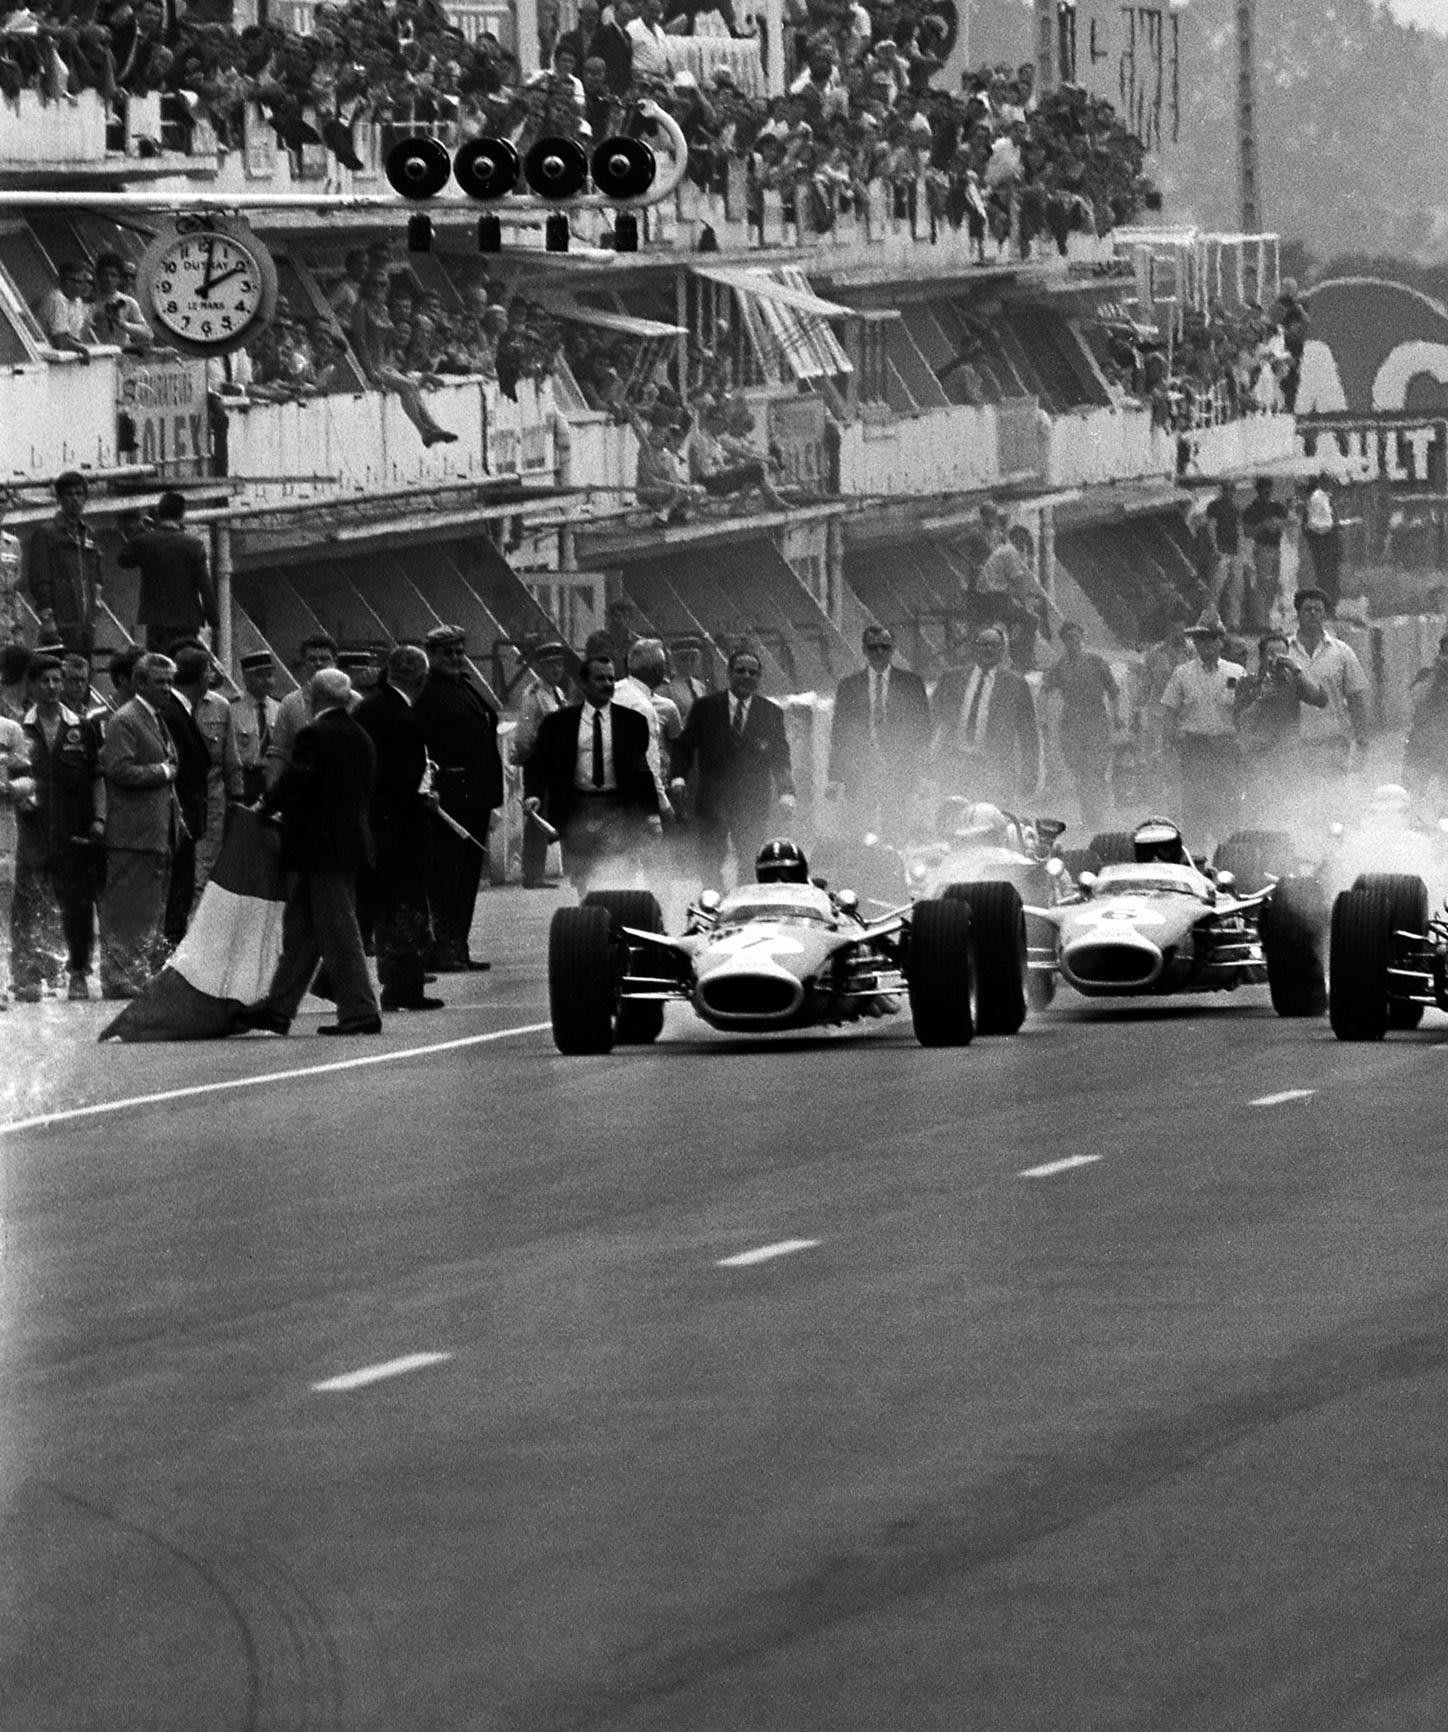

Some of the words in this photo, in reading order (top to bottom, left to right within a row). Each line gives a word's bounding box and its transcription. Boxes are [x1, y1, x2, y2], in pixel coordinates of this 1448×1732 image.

[183, 261, 228, 271] DUTAY
[127, 414, 202, 464] OLEX
[1296, 426, 1436, 483] AULT
[741, 936, 775, 949] 7
